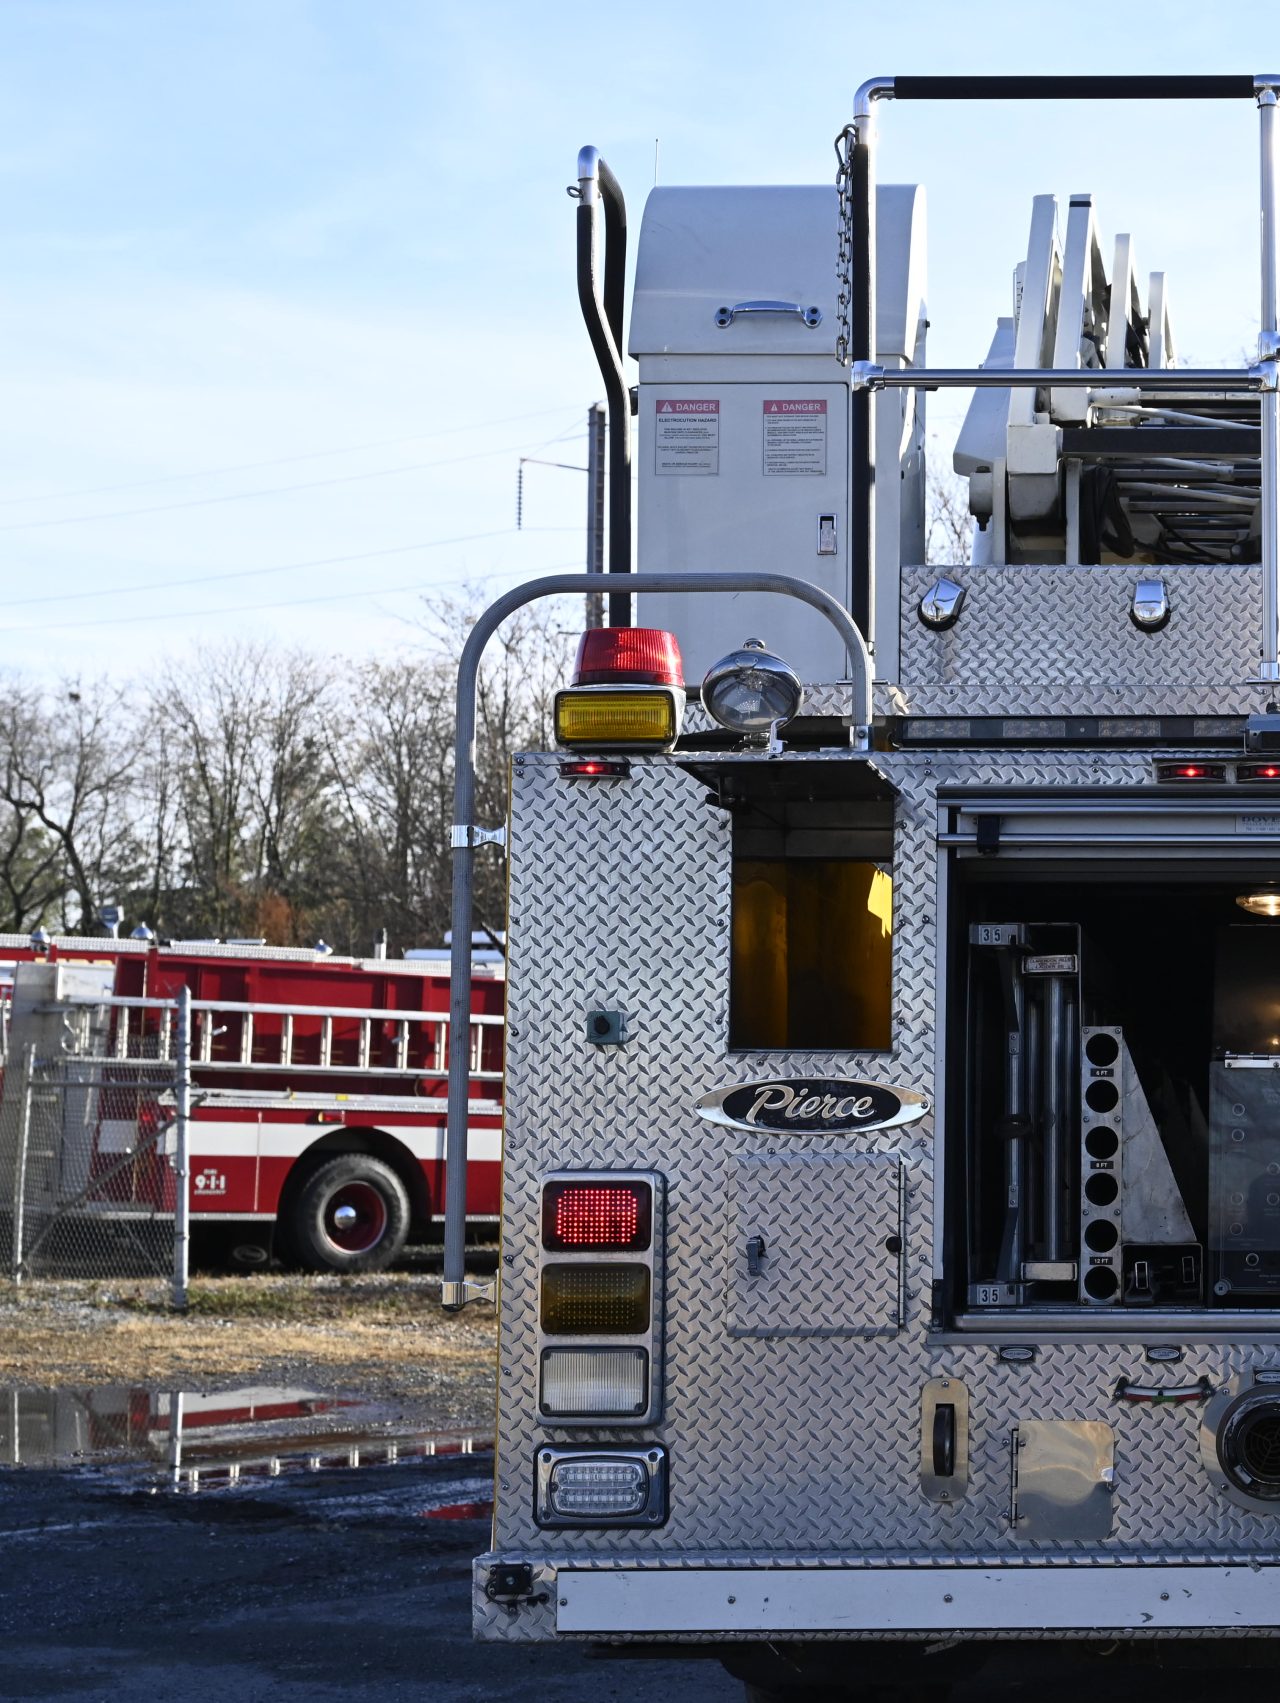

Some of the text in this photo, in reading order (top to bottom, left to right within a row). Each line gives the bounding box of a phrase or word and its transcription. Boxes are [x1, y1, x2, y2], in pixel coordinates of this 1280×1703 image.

[676, 403, 716, 411] DANGER
[983, 929, 1000, 942] 35
[745, 1084, 874, 1124] Pierce
[982, 1289, 998, 1302] 35
